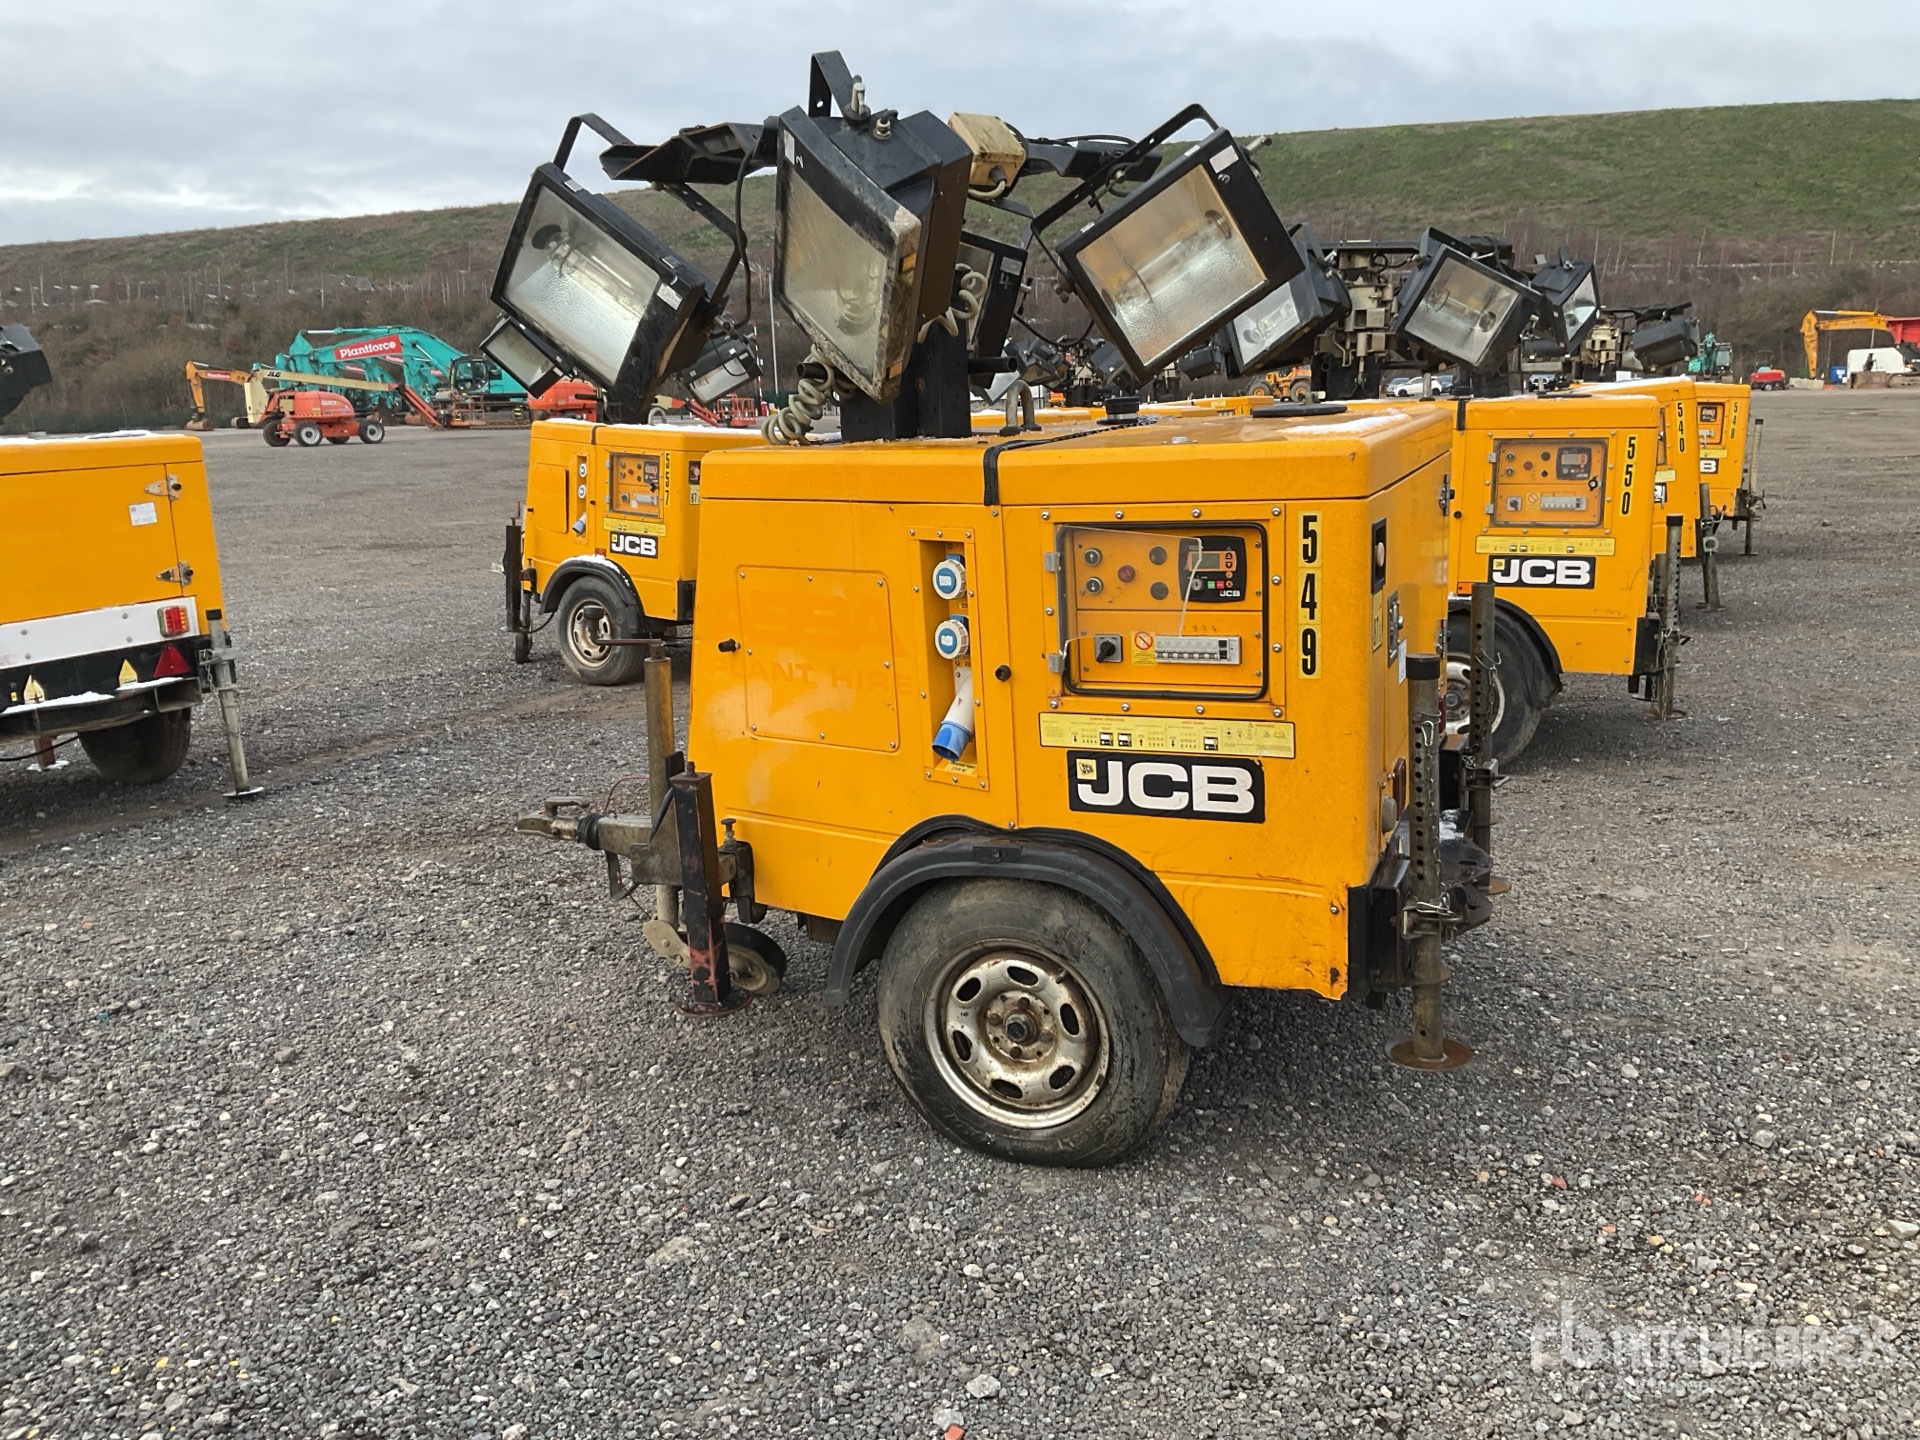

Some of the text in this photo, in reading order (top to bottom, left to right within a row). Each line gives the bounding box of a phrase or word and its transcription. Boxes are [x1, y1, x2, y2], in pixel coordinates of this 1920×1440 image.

[338, 340, 397, 359] Plantforce
[1677, 402, 1685, 452] 540
[1730, 402, 1739, 439] 548
[1621, 436, 1637, 515] 550
[611, 534, 657, 556] JCB
[1491, 559, 1591, 585] JCB
[1300, 514, 1318, 676] 549
[1077, 761, 1255, 814] JCB
